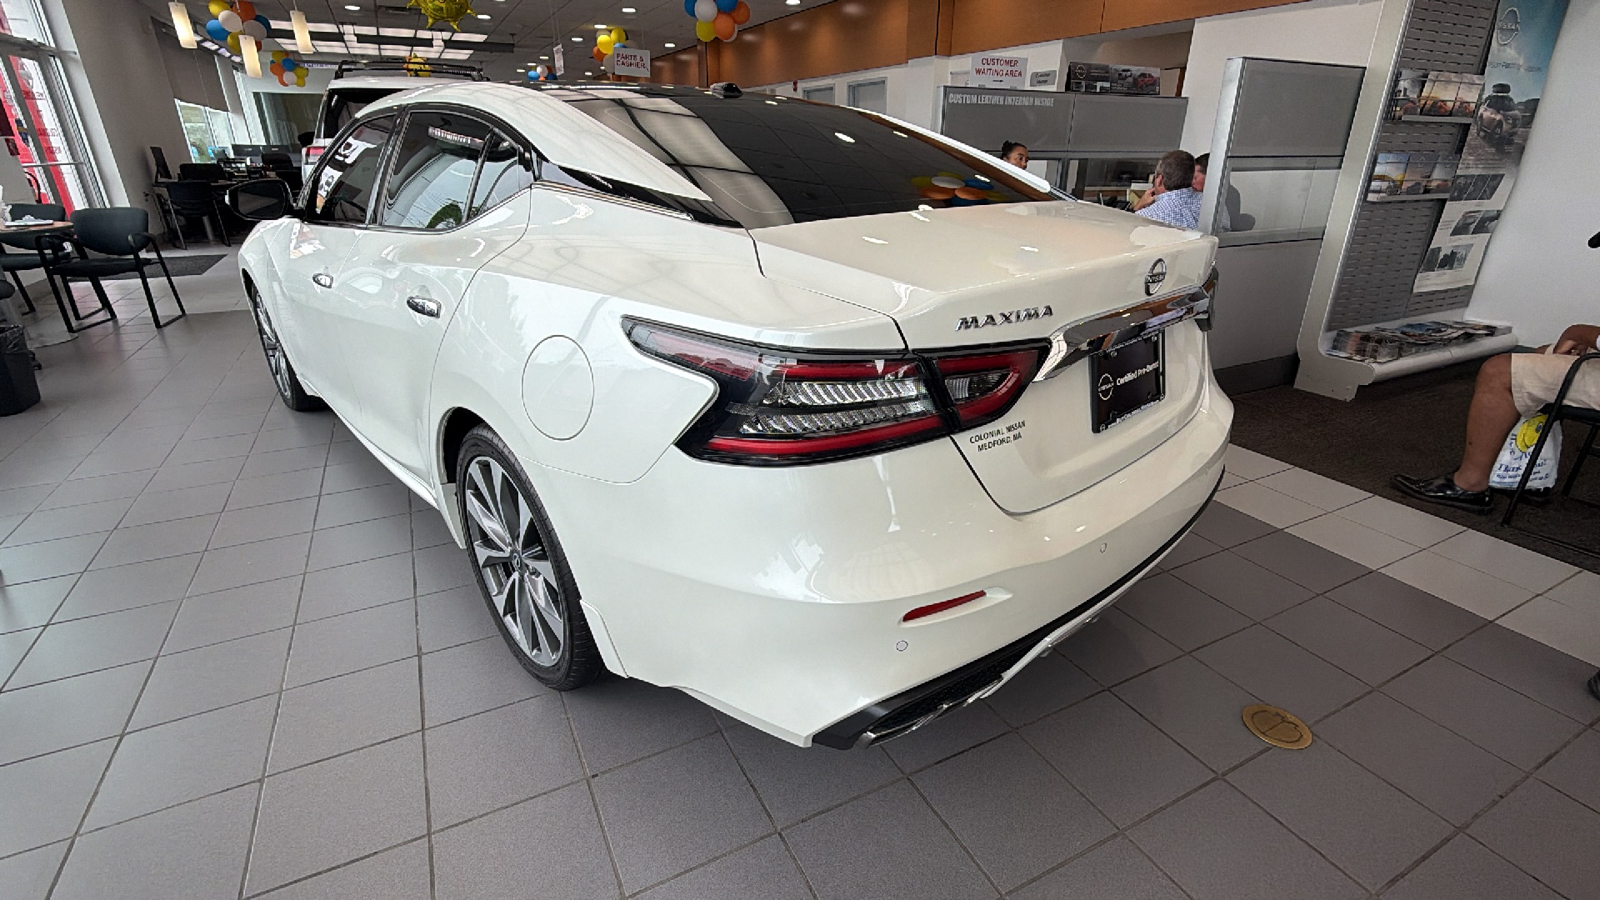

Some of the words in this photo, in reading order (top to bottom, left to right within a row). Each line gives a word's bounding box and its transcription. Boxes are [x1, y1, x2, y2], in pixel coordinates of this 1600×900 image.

[616, 53, 637, 61] PARTS
[981, 58, 1019, 67] CUSTOMER
[616, 60, 646, 68] CASHIER
[975, 68, 1004, 77] WAITING
[1005, 69, 1023, 78] AREA
[948, 93, 977, 104] CUSTOM
[978, 95, 1004, 105] LEATHER
[1005, 96, 1034, 106] INTERIOR
[955, 305, 1053, 331] MAXIMA
[1116, 370, 1138, 386] Certified
[970, 428, 1005, 444] COLONIAL
[1006, 420, 1026, 433] NISSAN
[977, 436, 1012, 452] MEDFORD,
